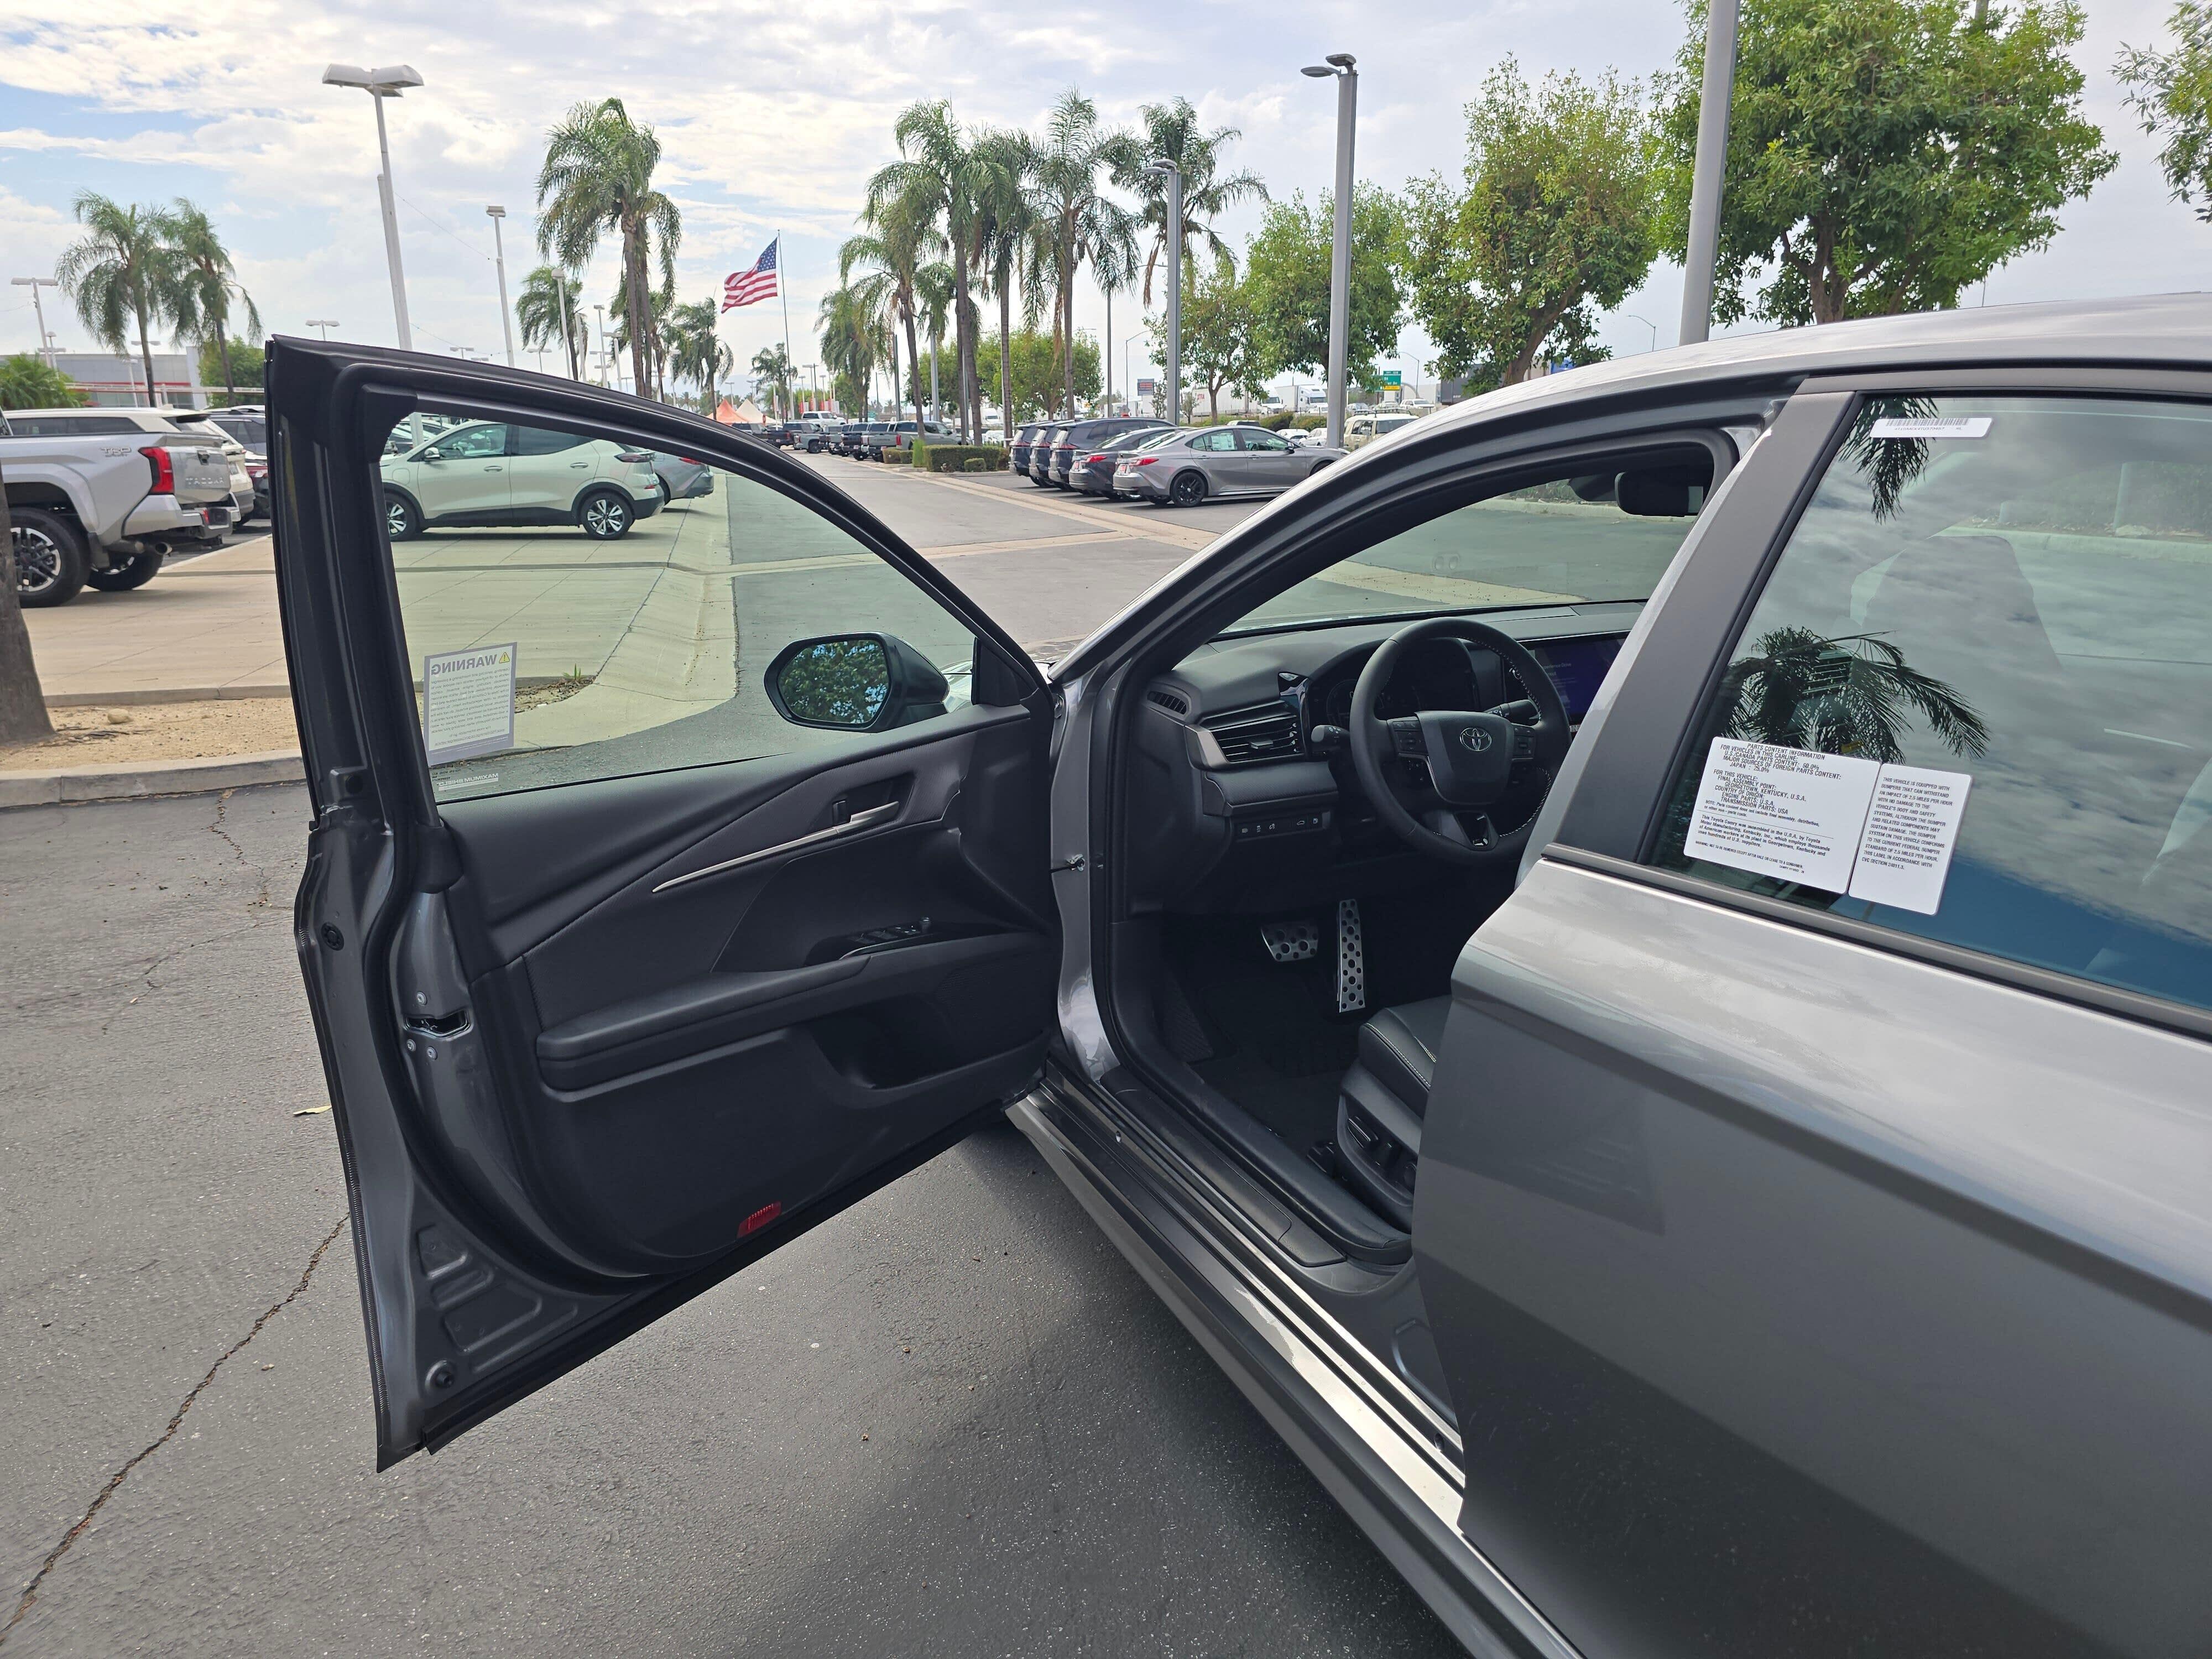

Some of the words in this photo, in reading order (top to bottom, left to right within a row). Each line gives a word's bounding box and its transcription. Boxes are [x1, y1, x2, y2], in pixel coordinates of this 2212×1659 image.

[100, 447, 132, 455] TRD
[1725, 750, 1755, 759] U.S./CANADA
[1789, 750, 1825, 760] INFORMATION
[1815, 771, 1841, 779] CONTENT:
[1733, 778, 1759, 786] ASSEMBLY
[1725, 782, 1759, 792] GEORGETOWN,
[1761, 789, 1788, 799] KENTUCKY,
[1721, 797, 1757, 808] TRANSMISSION
[1758, 804, 1776, 812] PARTS:
[1901, 822, 1929, 831] COMPONENTS
[1892, 856, 1920, 865] ACCORDANCE
